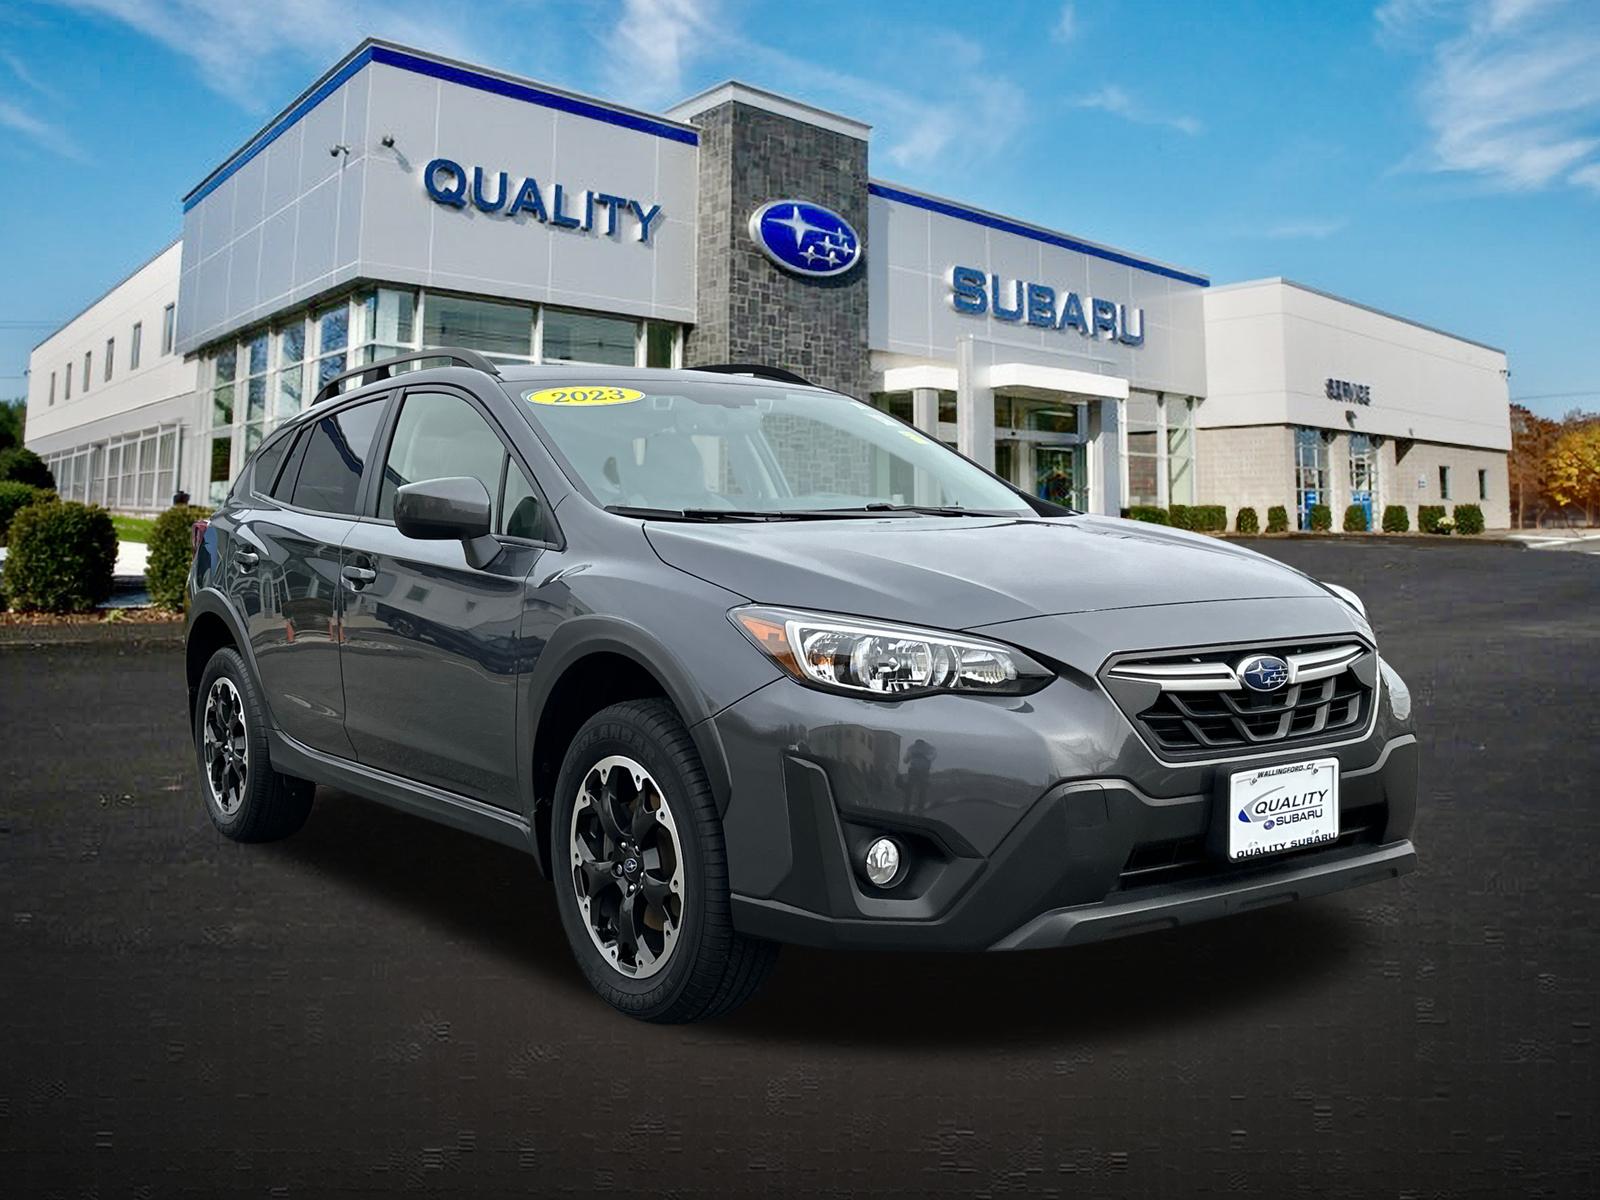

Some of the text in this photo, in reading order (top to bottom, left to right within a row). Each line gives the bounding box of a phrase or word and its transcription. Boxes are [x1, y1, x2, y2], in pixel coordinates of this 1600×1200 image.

[424, 158, 661, 242] QUALITY
[952, 265, 1144, 347] SUBARU
[551, 389, 625, 403] 2023
[1255, 789, 1328, 815] QUALITY
[1275, 808, 1322, 826] SUBARU
[1236, 832, 1336, 859] QUALITY SUBARU
